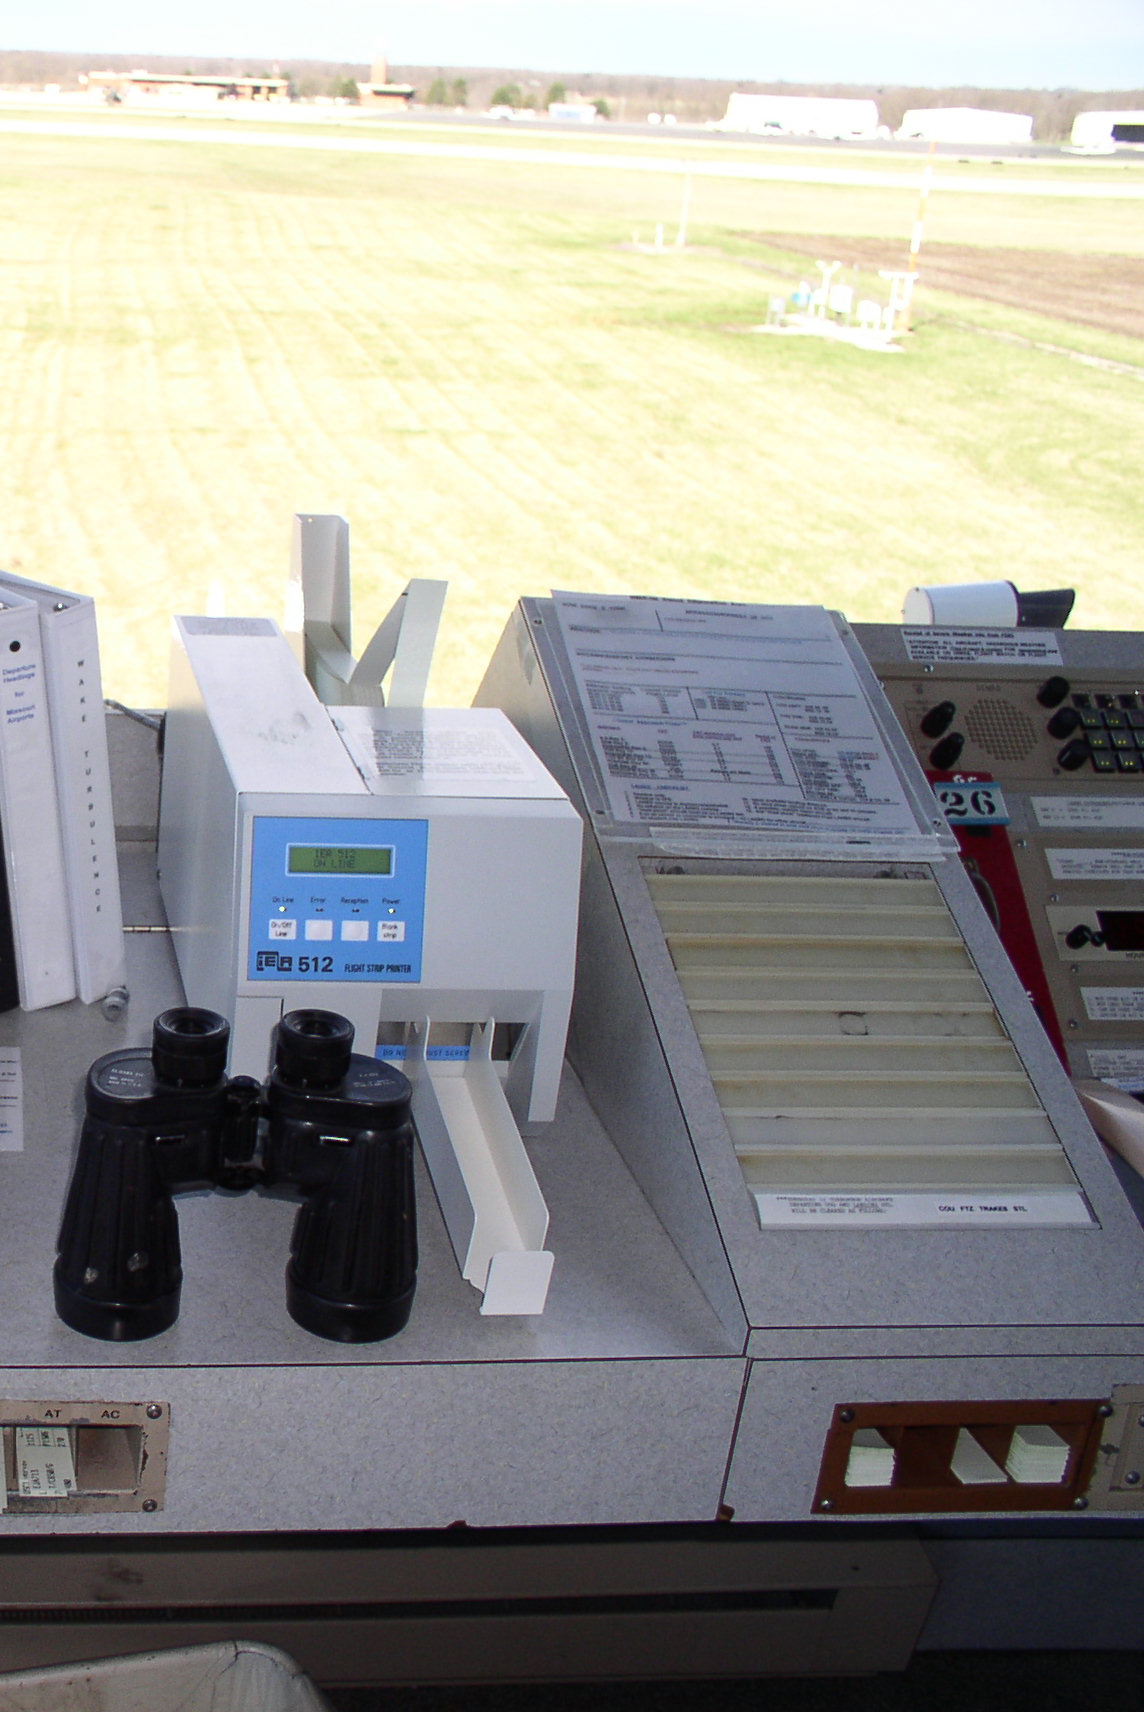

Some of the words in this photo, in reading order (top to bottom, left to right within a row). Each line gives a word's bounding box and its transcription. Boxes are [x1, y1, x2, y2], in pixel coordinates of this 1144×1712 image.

[939, 790, 997, 818] 26
[332, 858, 355, 869] LINE
[298, 956, 334, 973] 512
[344, 963, 366, 973] FLIGHT
[366, 963, 384, 973] STRIP
[385, 964, 412, 974] PRINTER
[44, 1408, 62, 1418] AT
[100, 1409, 121, 1419] AC
